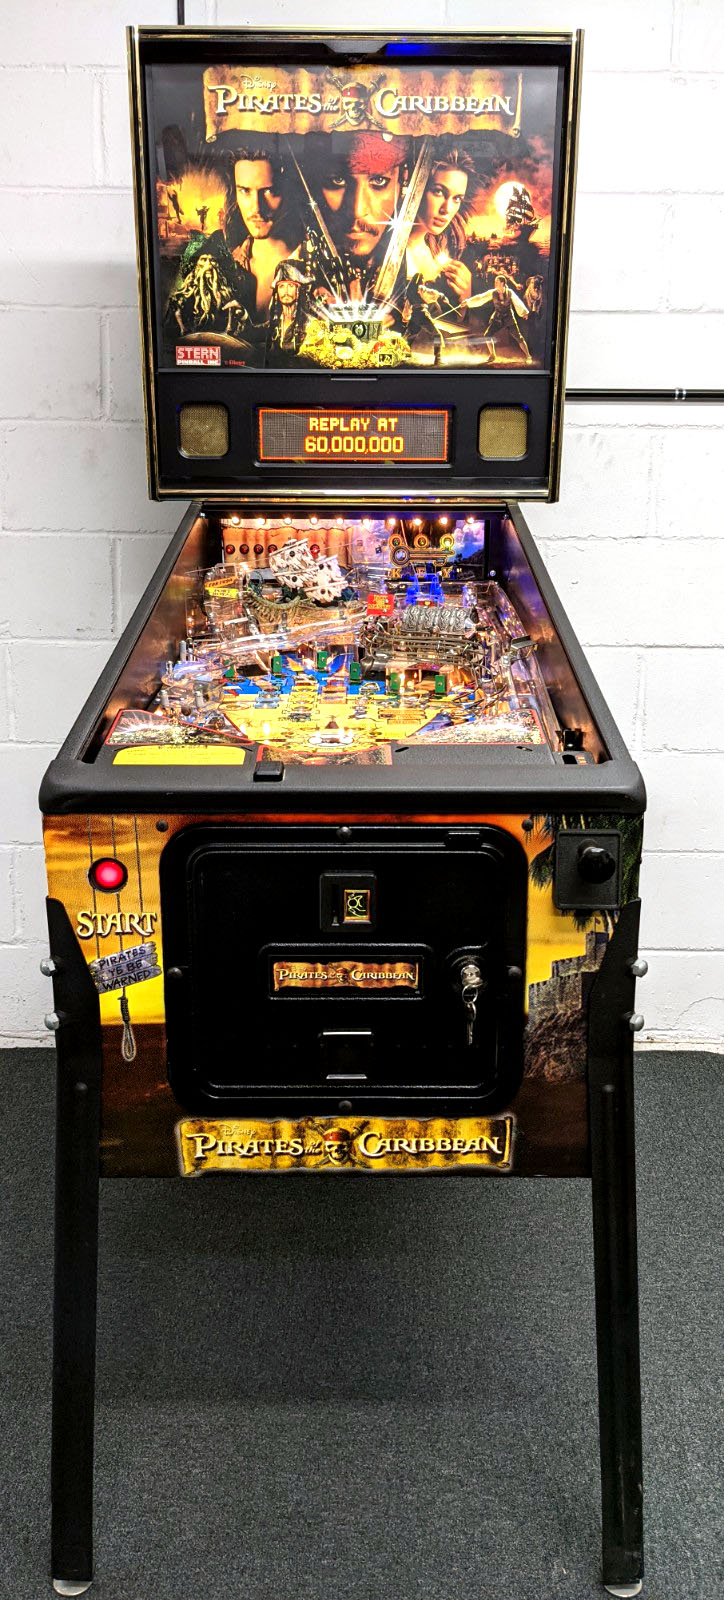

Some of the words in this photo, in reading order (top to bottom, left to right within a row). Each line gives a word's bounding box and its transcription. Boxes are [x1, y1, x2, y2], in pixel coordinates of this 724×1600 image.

[207, 85, 323, 114] PIRATES
[374, 87, 515, 116] CARIBBEAN
[177, 347, 219, 360] STERN
[309, 417, 370, 432] REPLAY
[377, 418, 398, 432] AT
[305, 436, 404, 454] 60,000,000
[76, 910, 158, 938] START
[98, 946, 146, 969] PIRATES
[108, 966, 123, 977] YE
[127, 959, 143, 971] BE
[276, 968, 328, 980] PIRATES
[351, 969, 416, 981] CARIBBEAN
[103, 970, 151, 990] WARNED
[186, 1132, 305, 1158] PIRATES
[358, 1131, 503, 1158] CARIBBEAN
